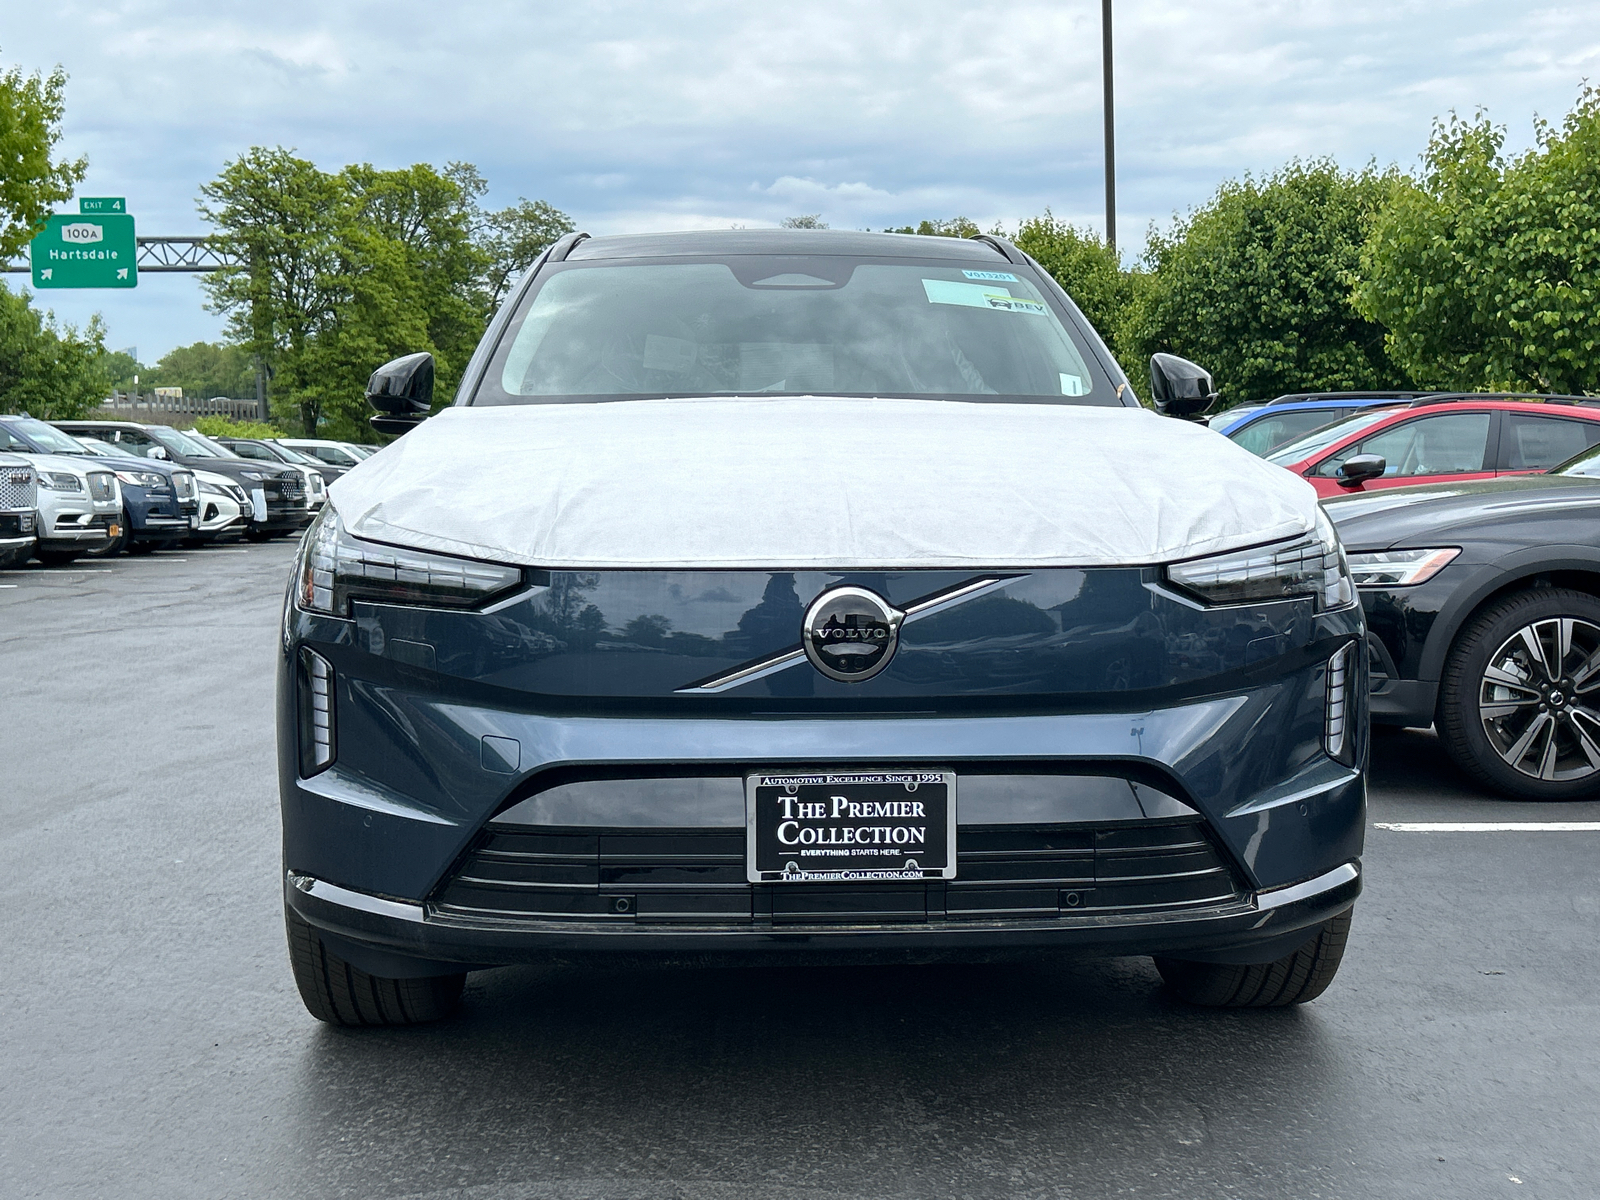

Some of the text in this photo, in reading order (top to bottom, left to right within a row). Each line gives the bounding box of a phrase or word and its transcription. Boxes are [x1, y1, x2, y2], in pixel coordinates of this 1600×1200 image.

[83, 200, 121, 210] EXIT 4
[67, 229, 98, 239] 100A
[49, 249, 118, 260] Hartsdale
[1014, 302, 1043, 312] BEV
[815, 628, 886, 639] VOLVO
[762, 774, 942, 785] AUTOMOTIVE EXCELLENCE SINCE 1995
[777, 796, 926, 819] THE PREMIER
[777, 820, 926, 845] COLLECTION
[800, 849, 850, 857] EVERYTHING
